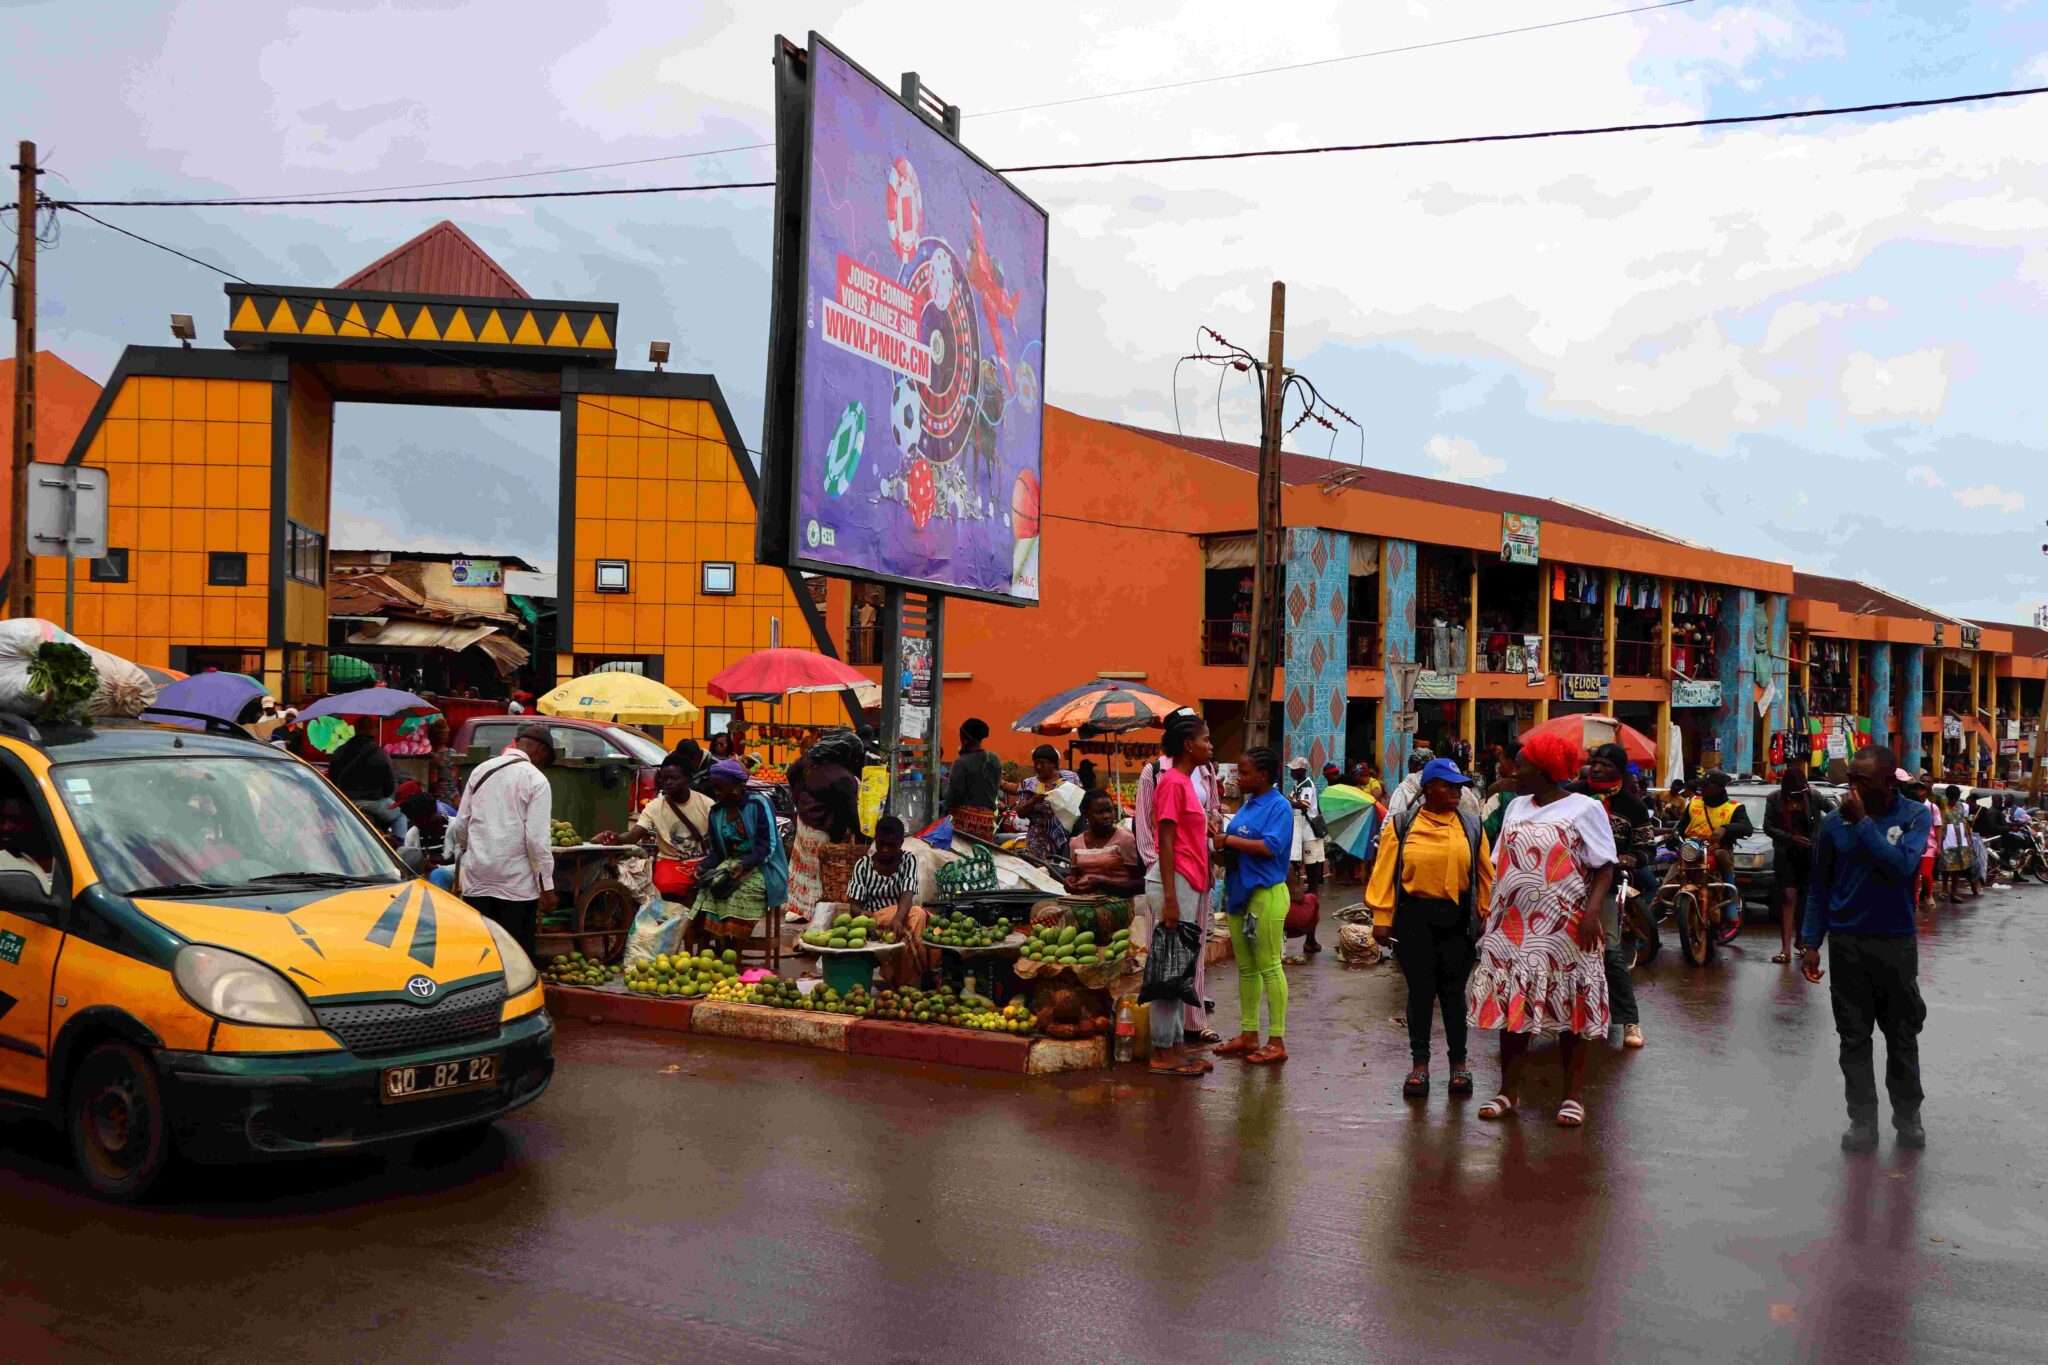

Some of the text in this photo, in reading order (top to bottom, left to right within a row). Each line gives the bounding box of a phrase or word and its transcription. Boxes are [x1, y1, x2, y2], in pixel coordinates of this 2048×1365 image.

[841, 285, 868, 316] VOUS
[869, 299, 898, 331] AIMEZ
[900, 314, 918, 340] SUR
[847, 264, 914, 314] JOUEZ COMME
[825, 304, 929, 379] WWW.PMUC.CM
[434, 1063, 459, 1087] 82
[469, 1057, 491, 1080] 22
